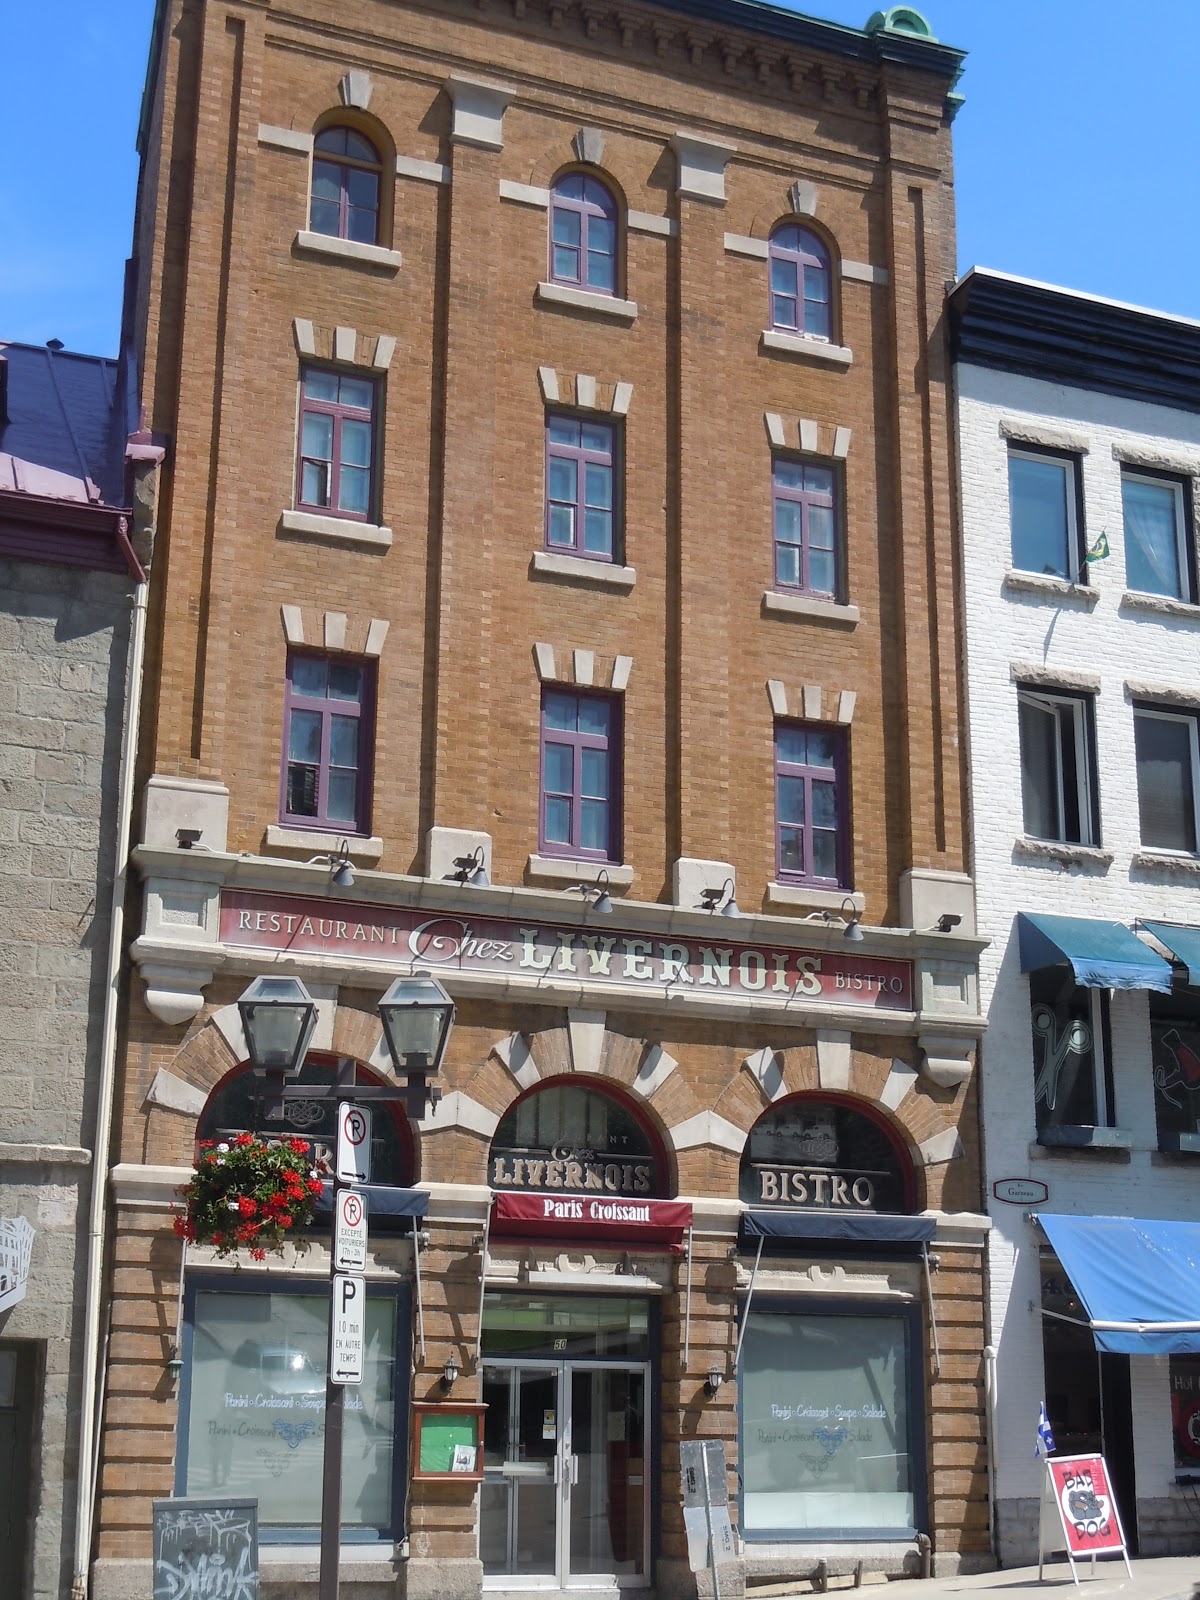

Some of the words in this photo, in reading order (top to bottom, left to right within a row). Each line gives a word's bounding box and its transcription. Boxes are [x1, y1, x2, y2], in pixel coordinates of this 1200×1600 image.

[238, 910, 400, 945] RESTAURANT
[407, 918, 514, 963] Chez
[518, 927, 824, 996] LIVERNOIS
[834, 971, 904, 995] BISTRO
[493, 1157, 651, 1193] LIVERNOIS
[760, 1171, 875, 1207] BISTRO
[543, 1199, 583, 1219] Paris
[590, 1201, 650, 1222] Croissant
[342, 1280, 356, 1314] P
[338, 1321, 347, 1333] 10
[349, 1322, 359, 1334] min
[335, 1340, 343, 1349] EN
[345, 1340, 361, 1350] AUTRE
[554, 1339, 567, 1349] 50
[340, 1353, 357, 1363] TEMPS
[224, 1392, 249, 1409] Panini
[254, 1392, 294, 1409] Croissant
[770, 1403, 792, 1418] Panini
[796, 1404, 830, 1418] Croissant
[834, 1404, 857, 1422] Soupe
[861, 1404, 887, 1419] Salade
[1062, 1468, 1093, 1491] BAD
[1073, 1517, 1112, 1541] DOG
